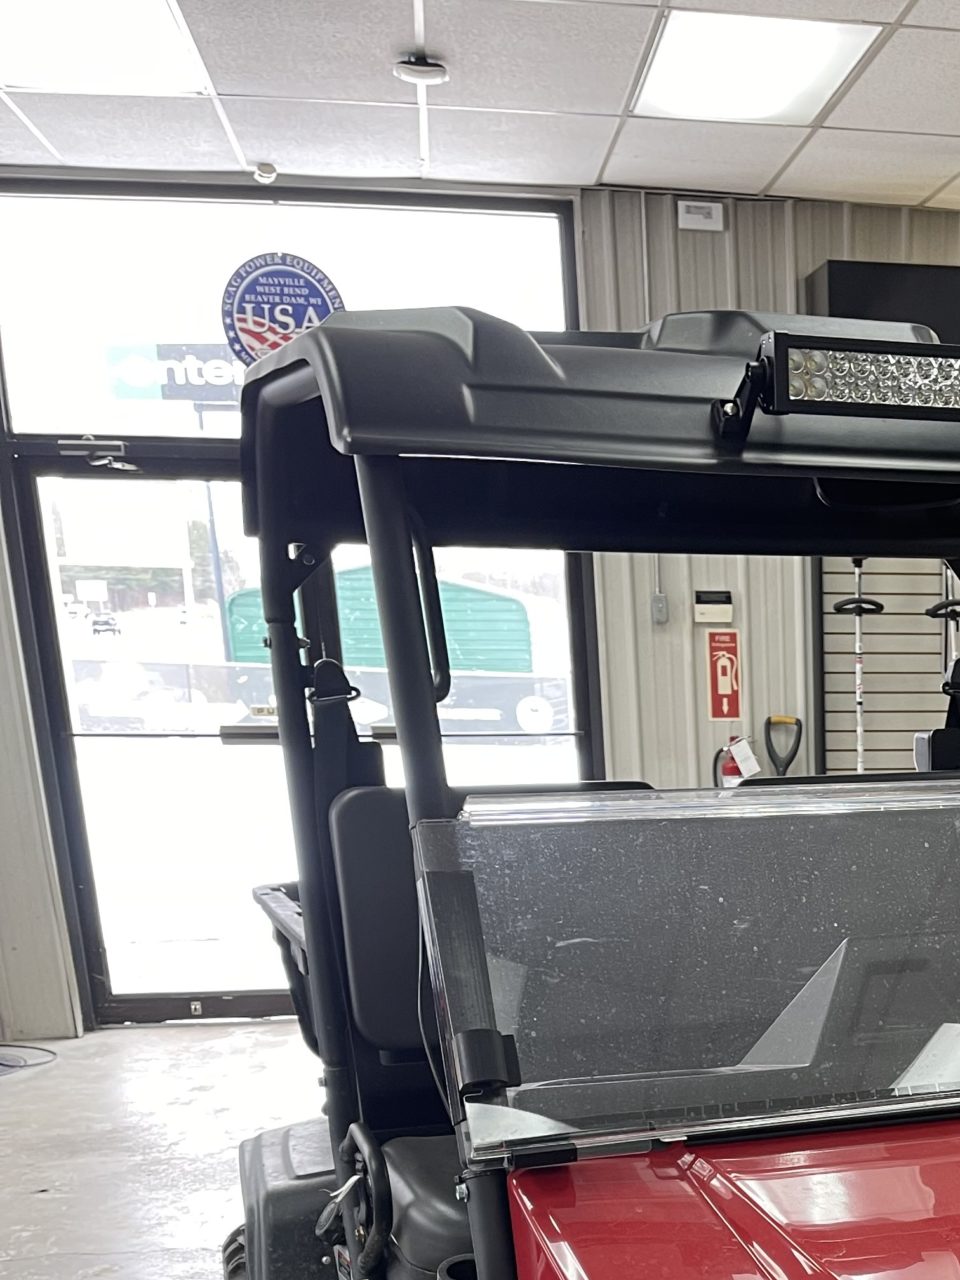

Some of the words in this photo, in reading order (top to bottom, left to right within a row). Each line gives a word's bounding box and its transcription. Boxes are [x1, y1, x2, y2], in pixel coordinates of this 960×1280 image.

[224, 277, 240, 311] SCAG
[240, 254, 282, 277] POWER
[286, 255, 344, 311] EQUIPMEN
[258, 276, 305, 286] MAYVILLE
[256, 285, 280, 294] WEST
[283, 286, 309, 295] BEND
[244, 294, 282, 303] BEAVER
[242, 303, 321, 334] USA
